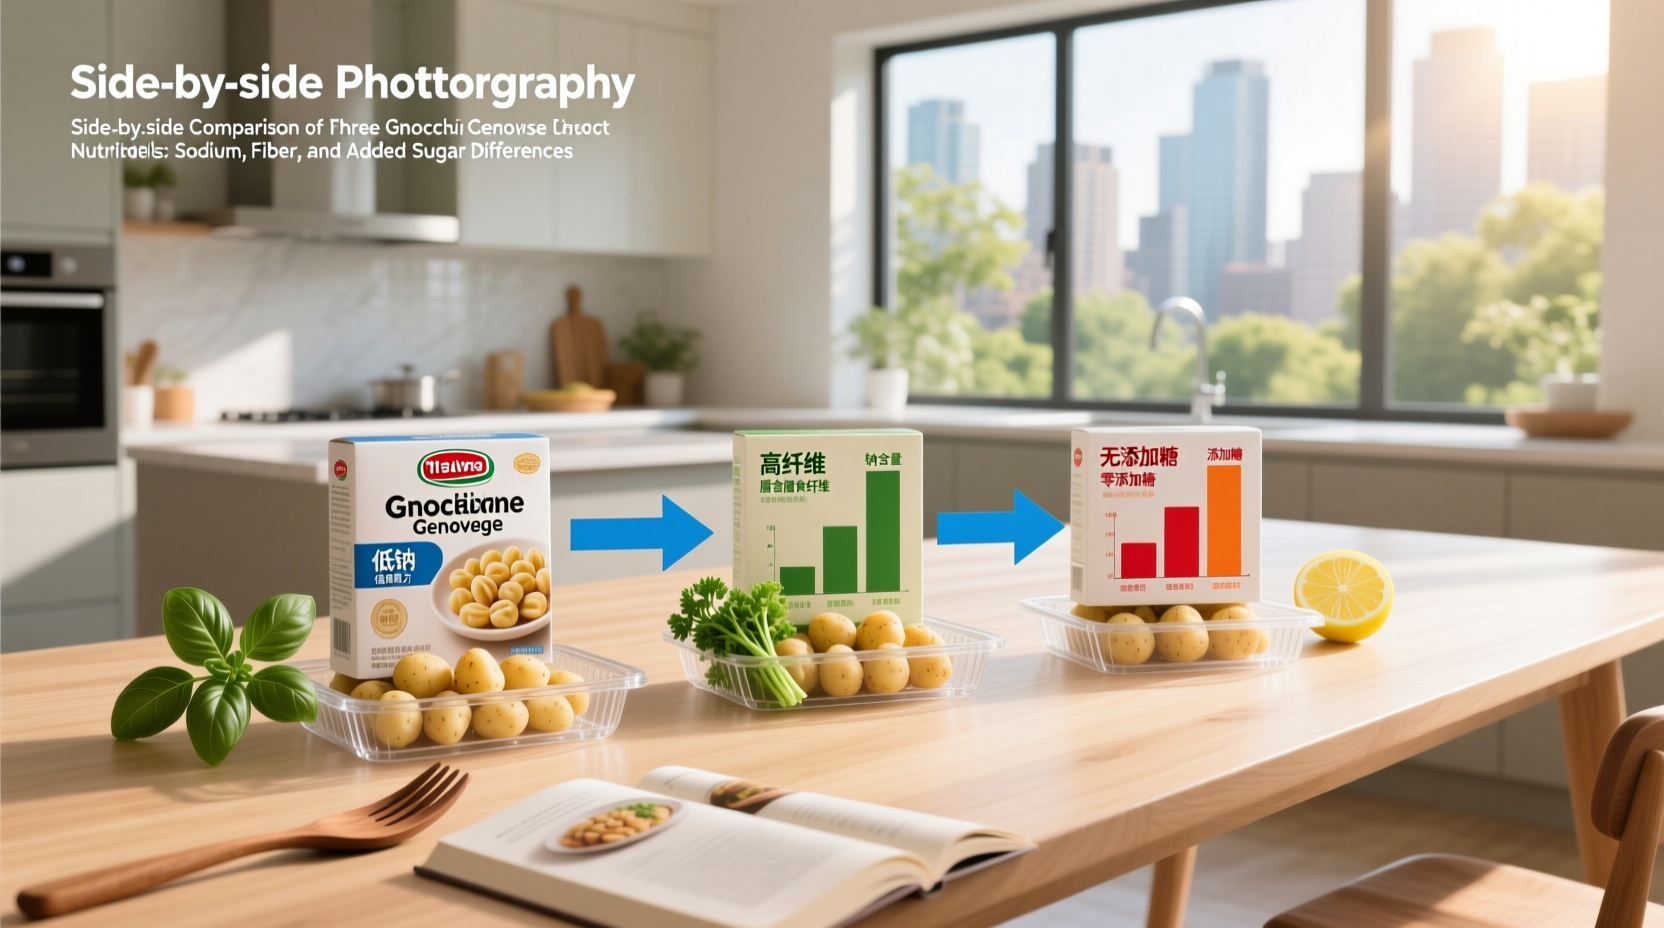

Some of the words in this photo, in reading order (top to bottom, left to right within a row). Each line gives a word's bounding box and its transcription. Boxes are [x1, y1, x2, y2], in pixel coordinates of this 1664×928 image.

[760, 451, 826, 476] 高纤维
[1100, 445, 1179, 468] 无添加糖
